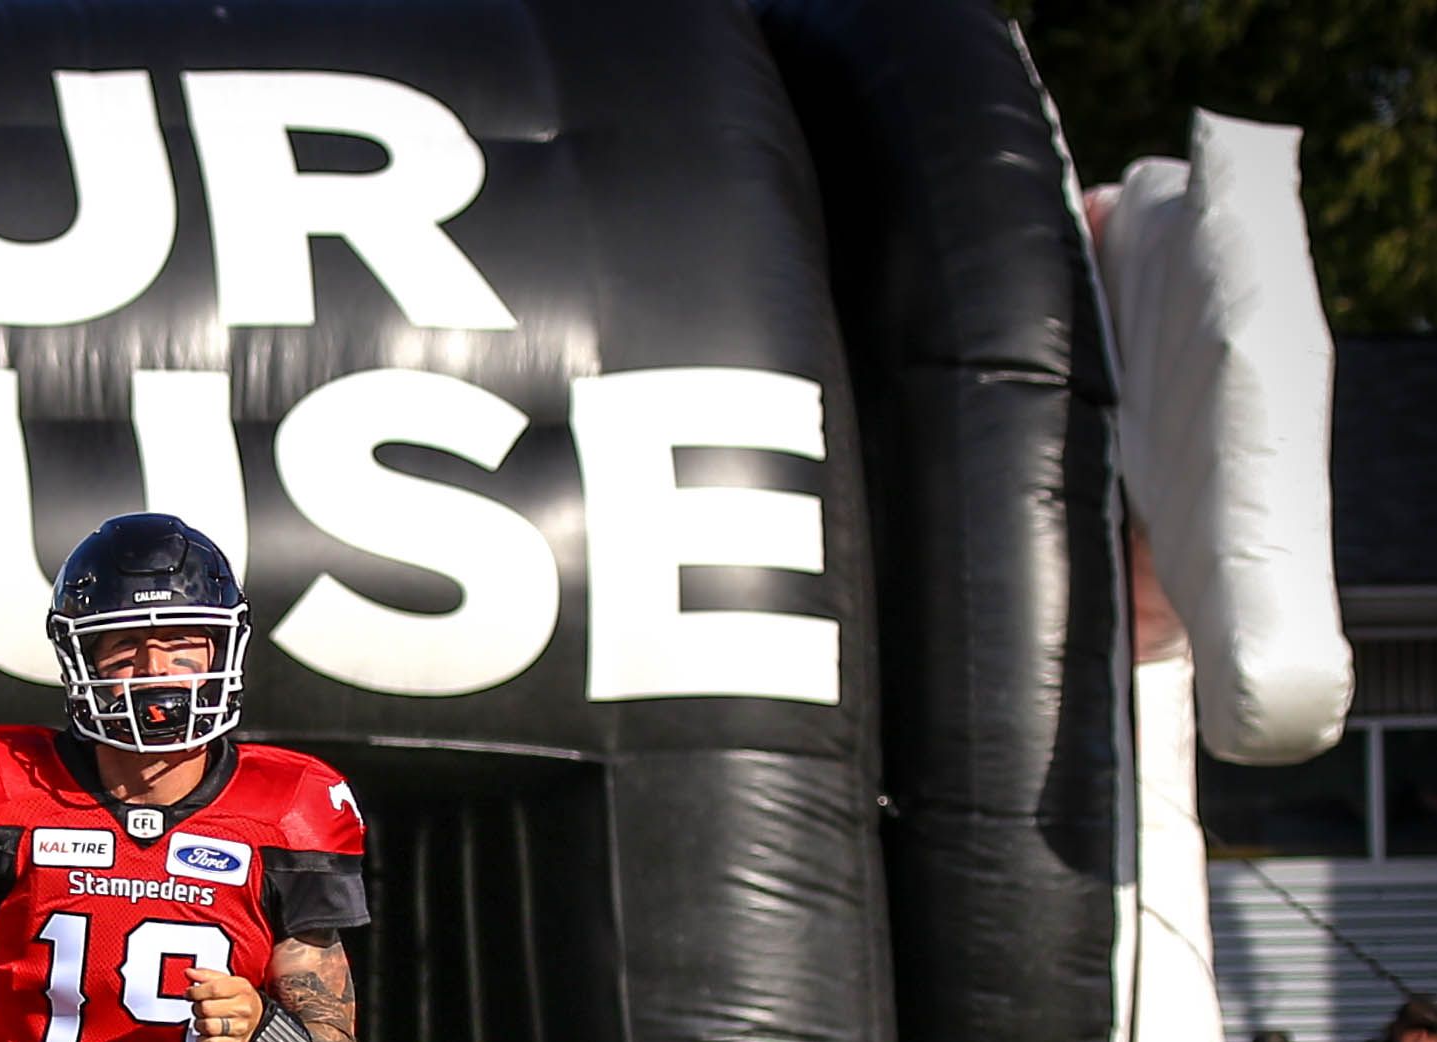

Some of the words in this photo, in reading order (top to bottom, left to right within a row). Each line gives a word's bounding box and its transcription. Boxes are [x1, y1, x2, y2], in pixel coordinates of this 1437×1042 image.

[133, 817, 157, 831] CFL
[188, 847, 228, 870] Ford
[68, 870, 216, 906] Stampeders
